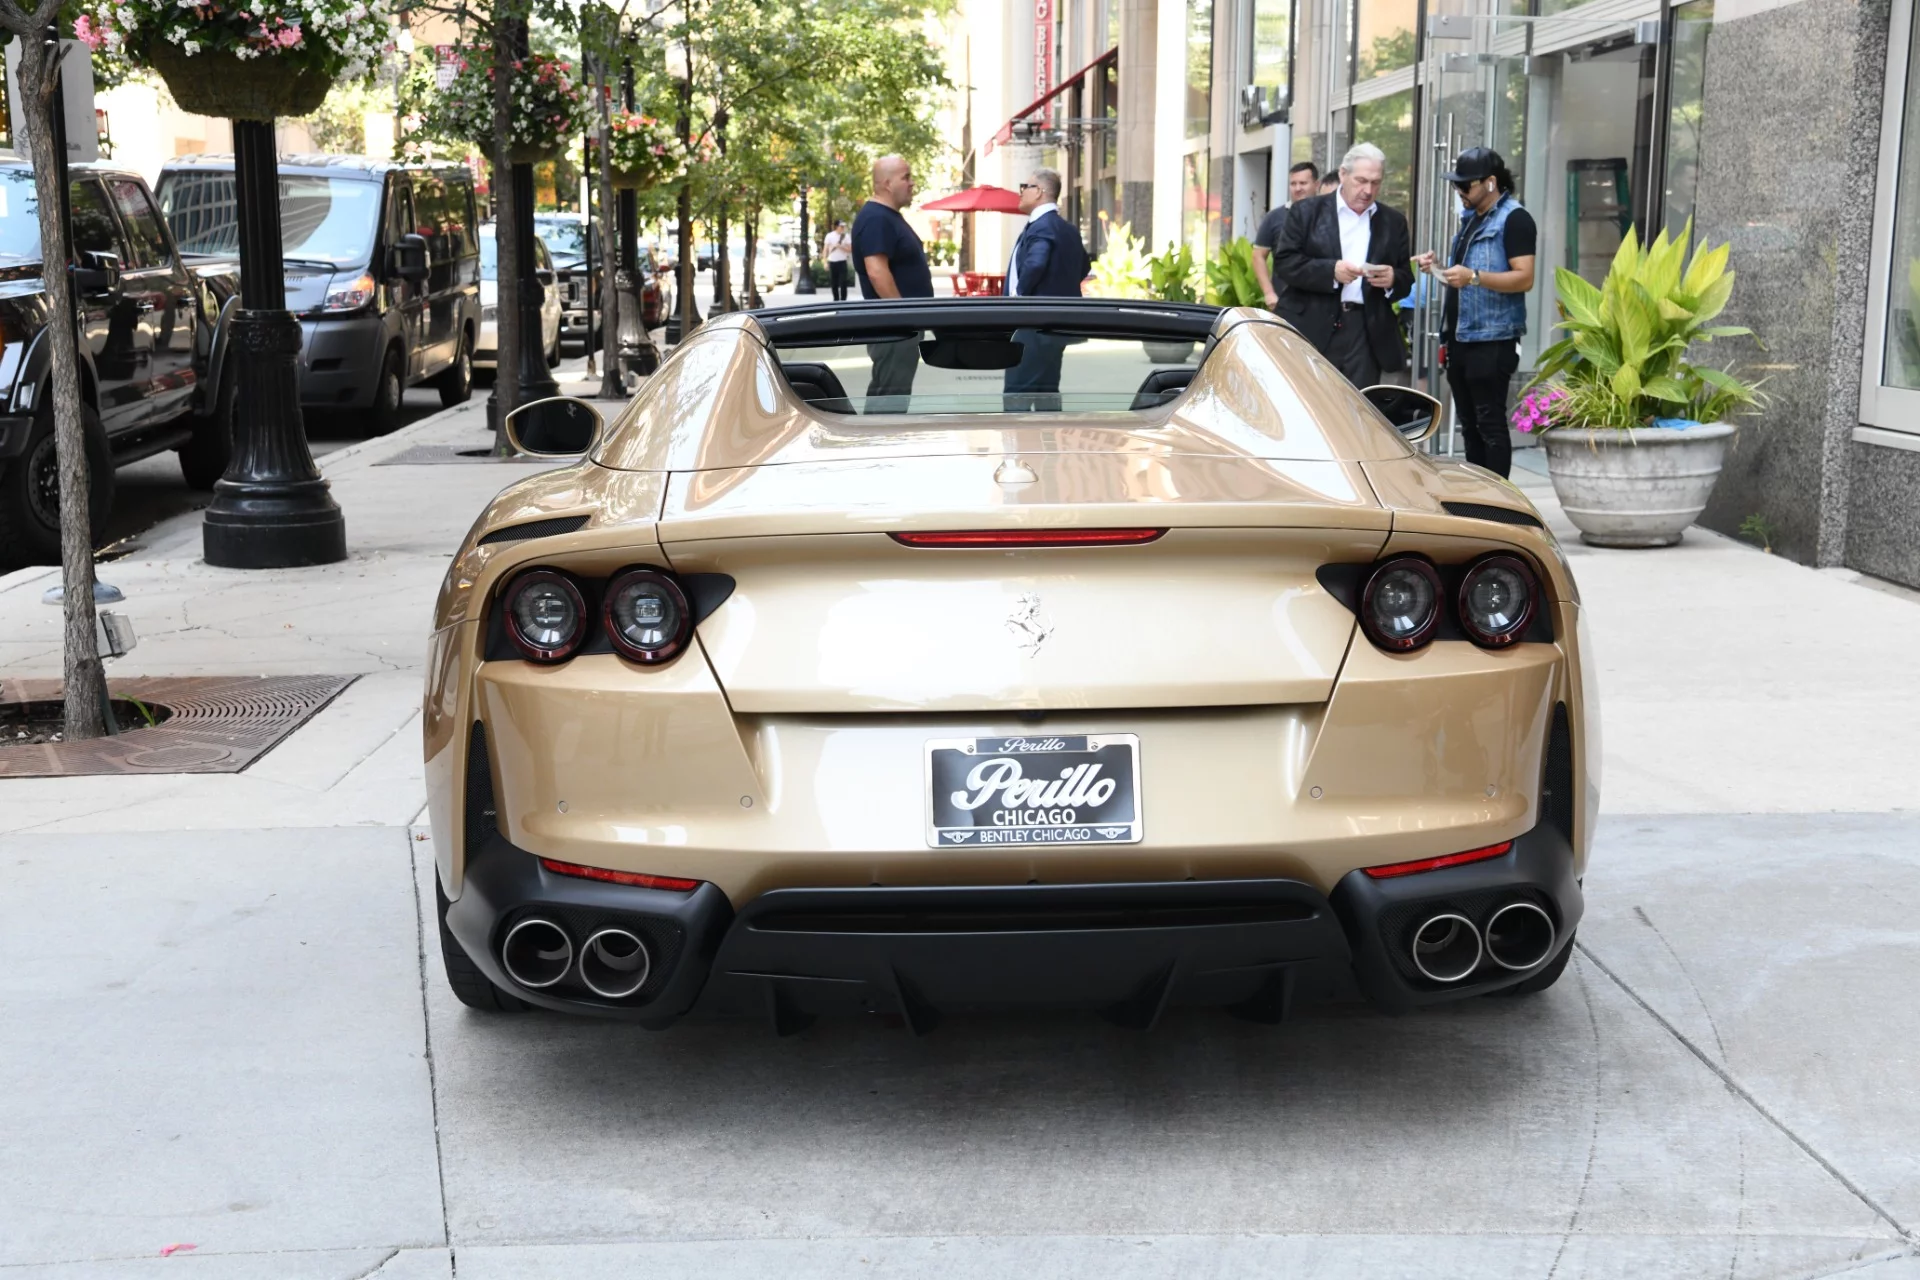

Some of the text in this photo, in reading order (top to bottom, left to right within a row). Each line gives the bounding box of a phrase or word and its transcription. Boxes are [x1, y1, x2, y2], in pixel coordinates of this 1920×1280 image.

[1036, 1, 1048, 20] C
[998, 738, 1066, 753] Perillo
[951, 757, 1116, 811] Perillo
[993, 808, 1076, 825] CHICAGO
[980, 828, 1091, 843] BENTLEY CHICAGO
